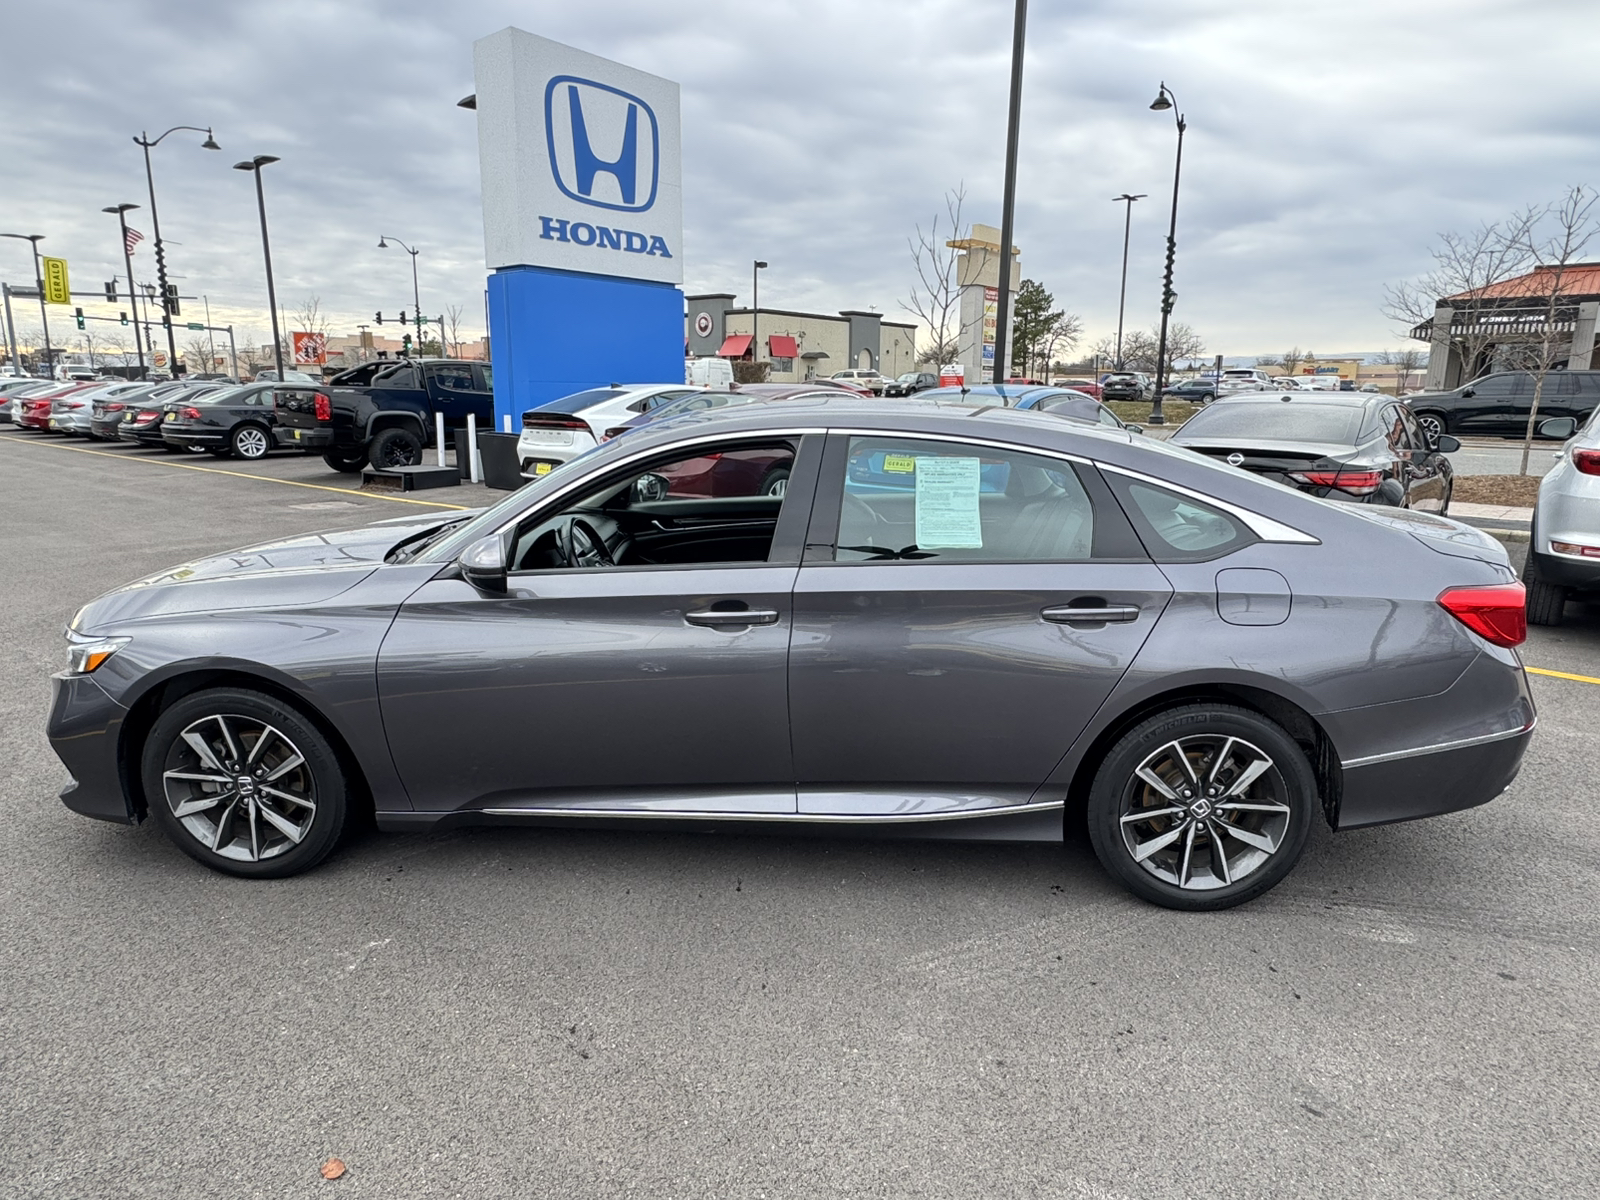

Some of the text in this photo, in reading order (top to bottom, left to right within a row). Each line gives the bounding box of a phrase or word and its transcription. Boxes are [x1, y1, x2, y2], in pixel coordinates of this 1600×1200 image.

[538, 215, 673, 258] HONDA
[51, 263, 62, 299] GERALD
[1155, 714, 1206, 736] MICHELIN
